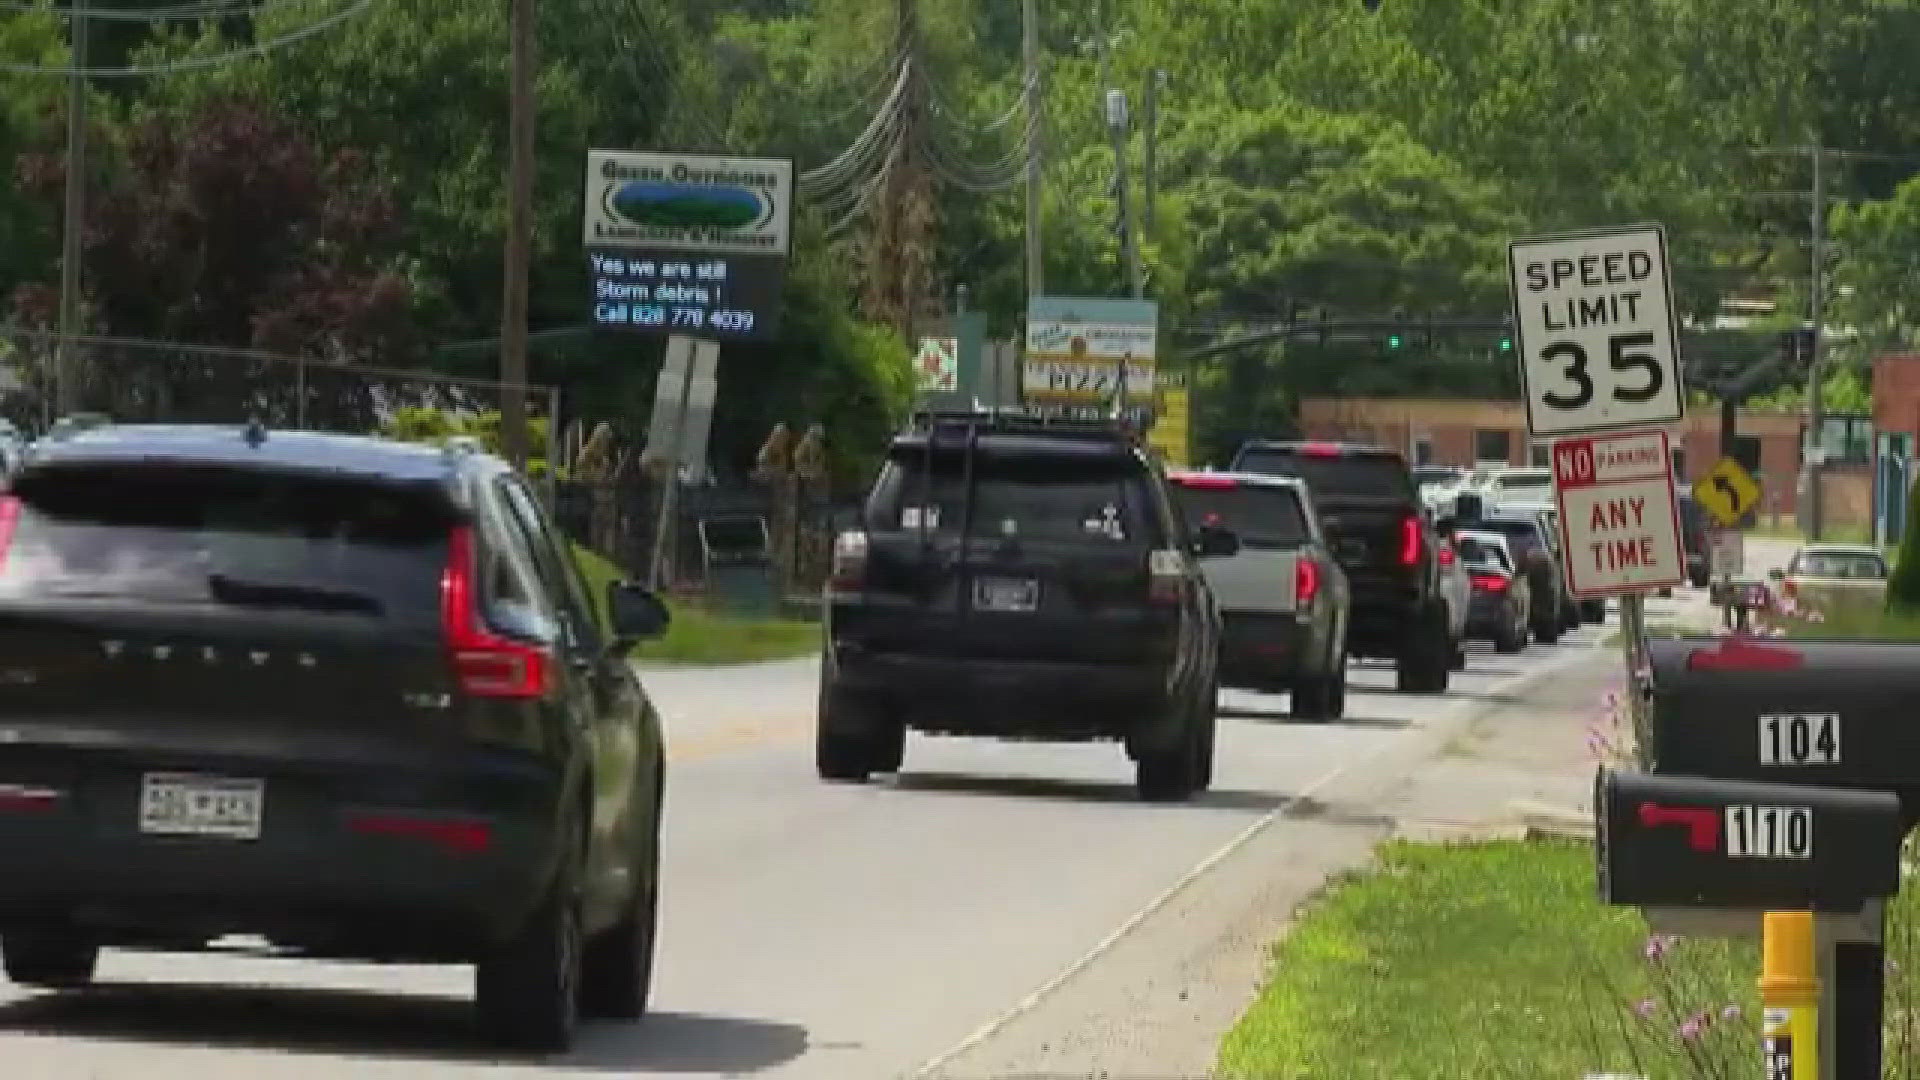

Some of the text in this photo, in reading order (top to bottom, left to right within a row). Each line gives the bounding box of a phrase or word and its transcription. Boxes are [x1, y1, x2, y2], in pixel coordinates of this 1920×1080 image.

[591, 252, 727, 280] Yes we are still
[1527, 251, 1652, 292] SPEED
[597, 279, 649, 299] Storm
[654, 282, 709, 303] debris
[595, 303, 628, 324] Call
[1542, 291, 1642, 331] LIMIT
[1539, 330, 1664, 410] 35
[1559, 446, 1660, 482] NO PARKING
[1590, 496, 1645, 533] ANY
[1590, 536, 1657, 573] TIME
[1766, 715, 1837, 763] 104
[1734, 808, 1808, 856] 110
